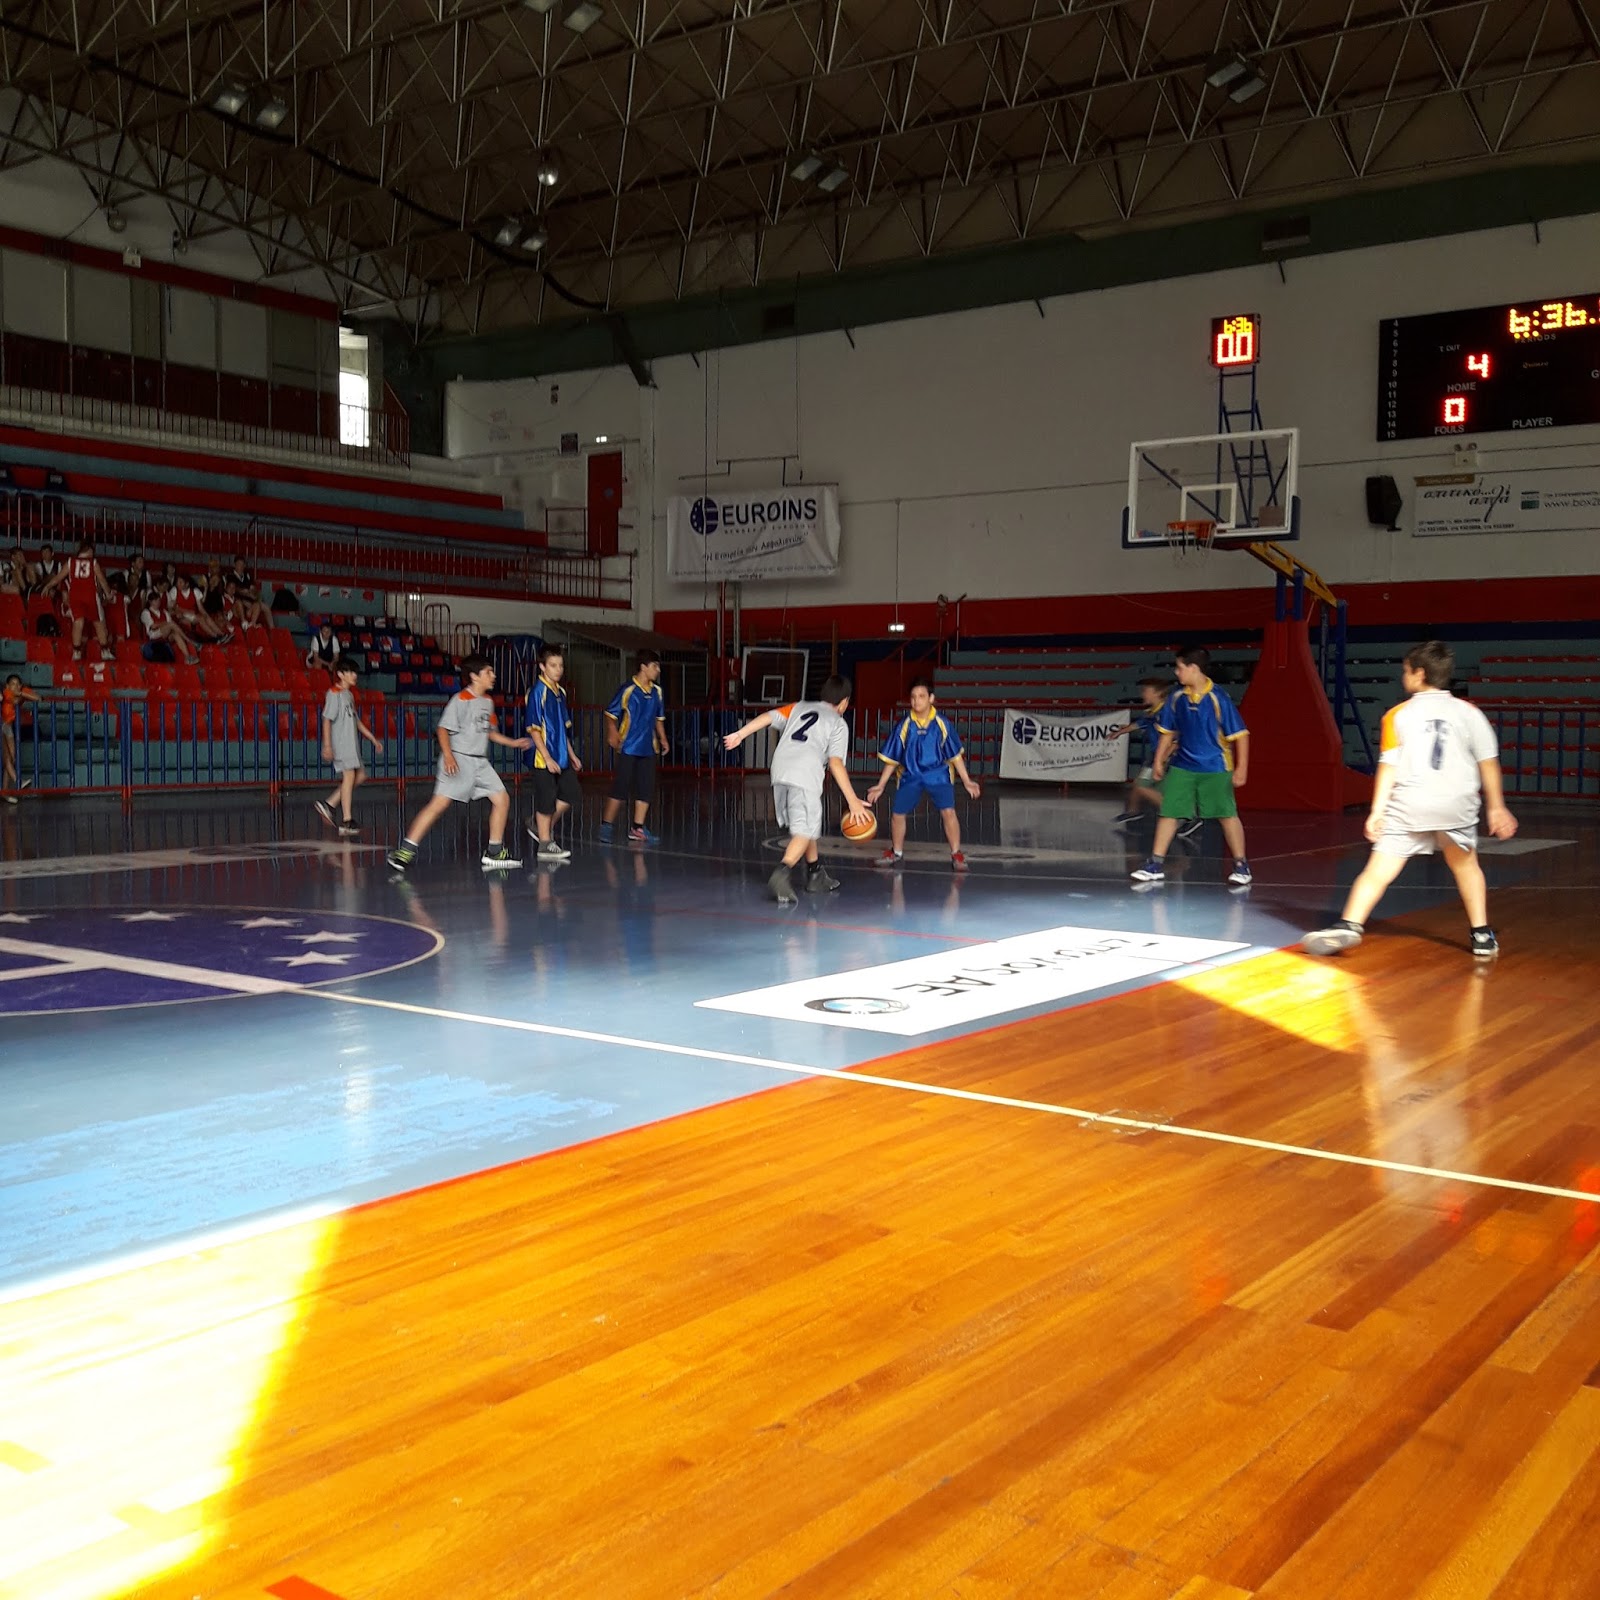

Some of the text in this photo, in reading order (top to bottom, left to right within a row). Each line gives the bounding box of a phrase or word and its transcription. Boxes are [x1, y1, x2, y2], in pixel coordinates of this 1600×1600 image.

[1467, 353, 1489, 379] 4
[1387, 380, 1398, 389] 10
[1447, 382, 1477, 393] HOME
[1387, 390, 1397, 399] 11
[1387, 400, 1397, 409] 12
[1444, 397, 1465, 423] 0
[1387, 410, 1397, 419] 13
[1387, 420, 1397, 429] 14
[1512, 416, 1554, 429] PLAYER
[1387, 430, 1397, 439] 15
[1434, 424, 1465, 436] FOULS
[722, 498, 818, 527] EUROINS
[75, 559, 91, 578] 13
[791, 710, 819, 742] 2
